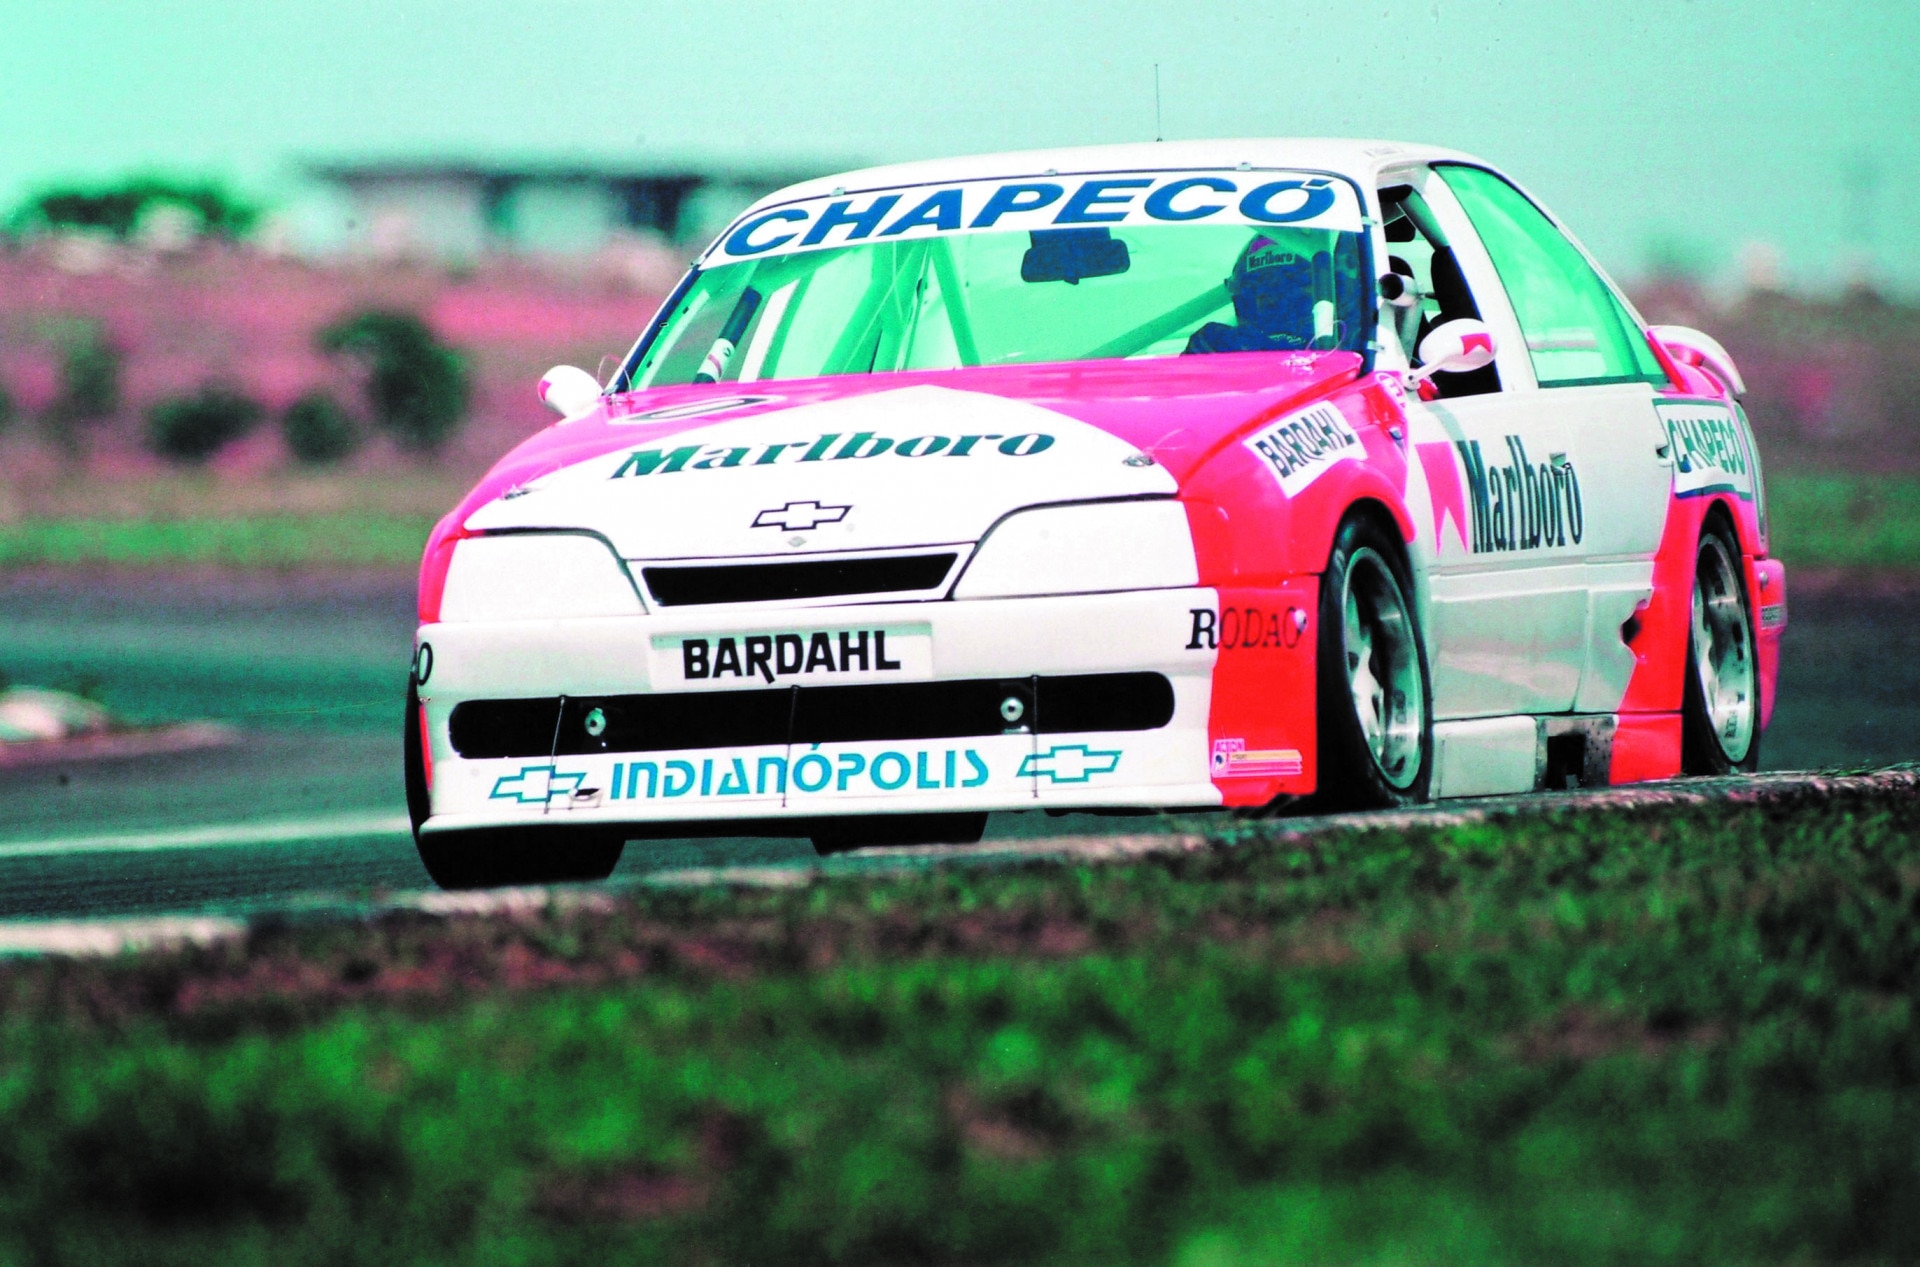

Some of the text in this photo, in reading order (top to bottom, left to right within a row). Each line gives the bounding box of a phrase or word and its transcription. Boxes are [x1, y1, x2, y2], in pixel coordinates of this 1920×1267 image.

[724, 177, 1336, 257] CHAPECÓ
[606, 431, 1056, 480] Marlboro
[1255, 408, 1356, 478] BARDAHL
[1457, 434, 1584, 554] Marlboro
[682, 630, 901, 684] BARDAHL
[610, 742, 989, 800] INDIANÓPOLIS
